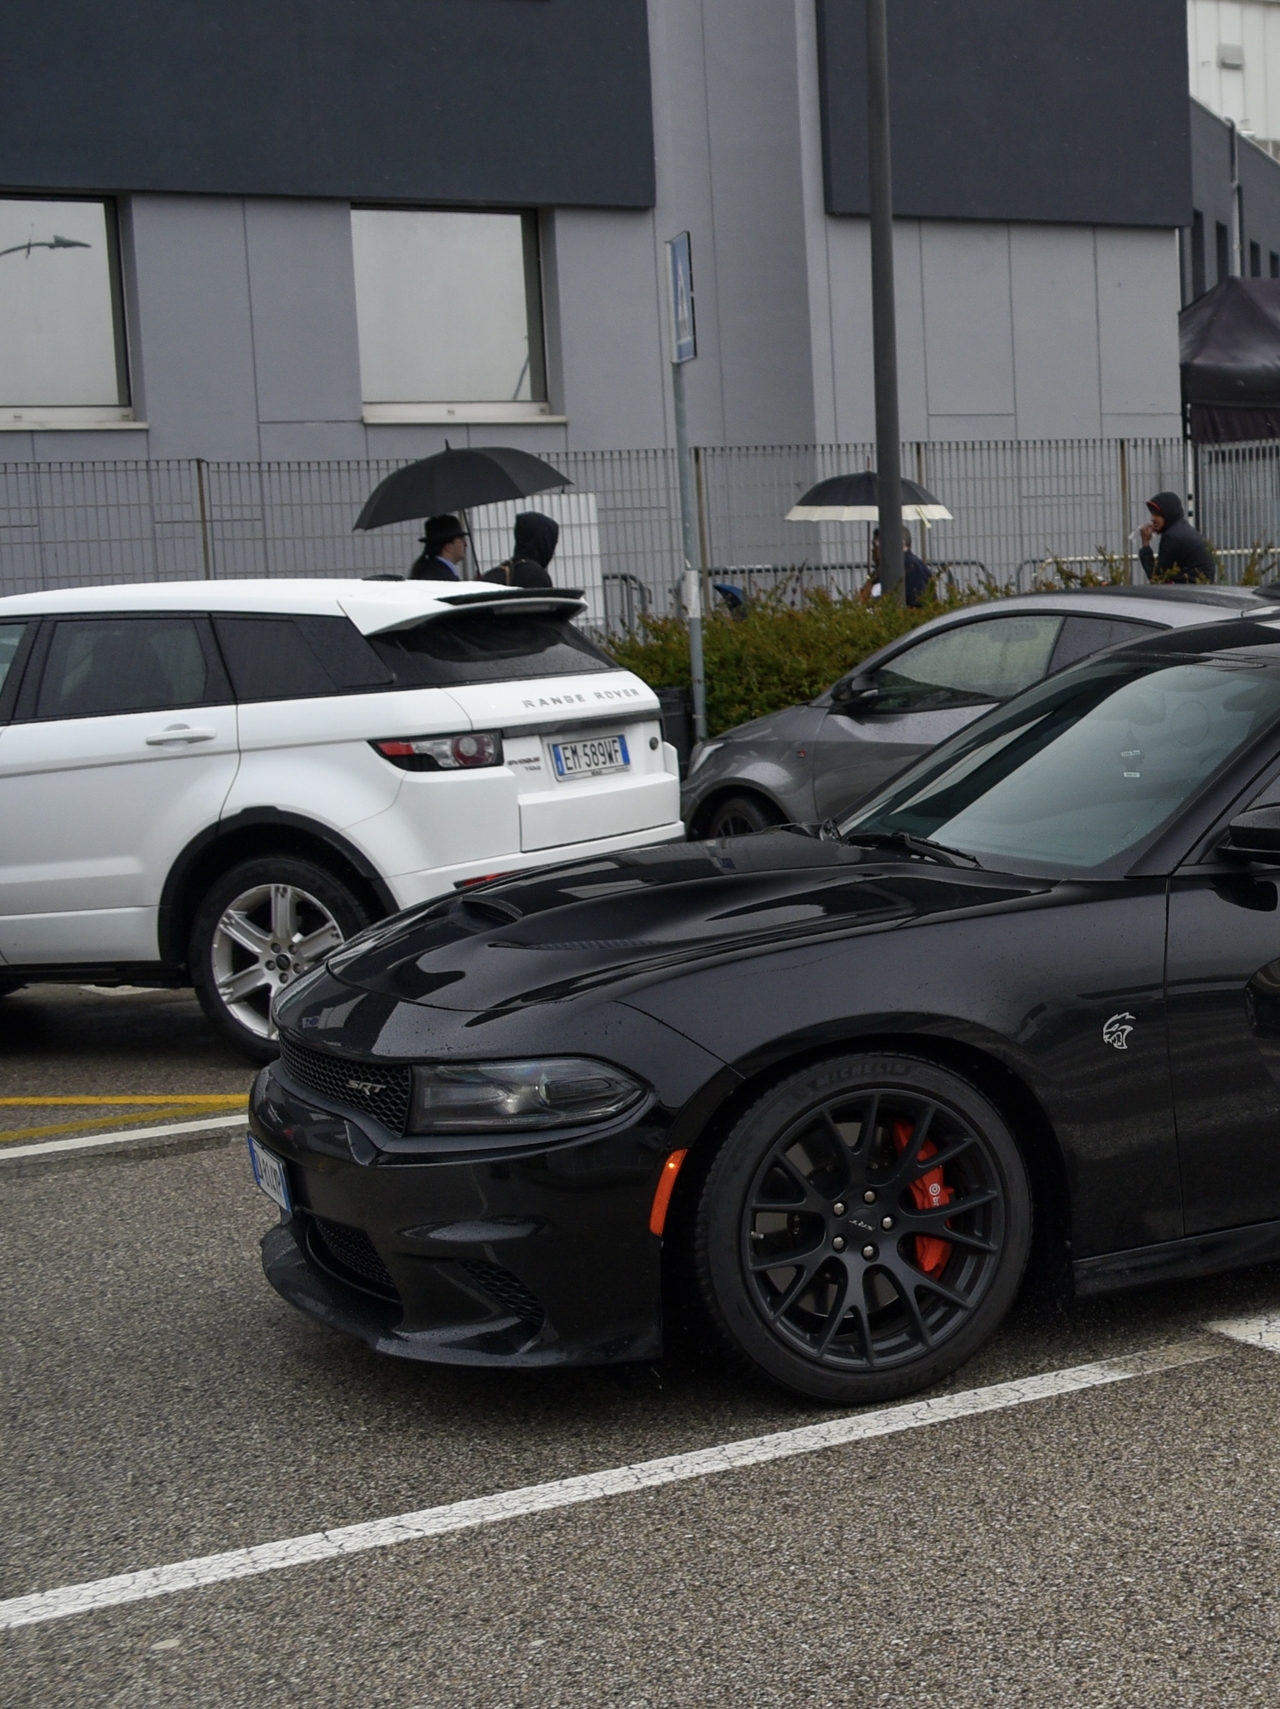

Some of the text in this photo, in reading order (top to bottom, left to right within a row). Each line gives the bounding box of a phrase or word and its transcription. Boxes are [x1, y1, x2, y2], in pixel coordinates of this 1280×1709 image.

[521, 688, 640, 708] RANGE ROVER
[816, 1062, 909, 1087] MICHELIN
[346, 1079, 387, 1095] SRT
